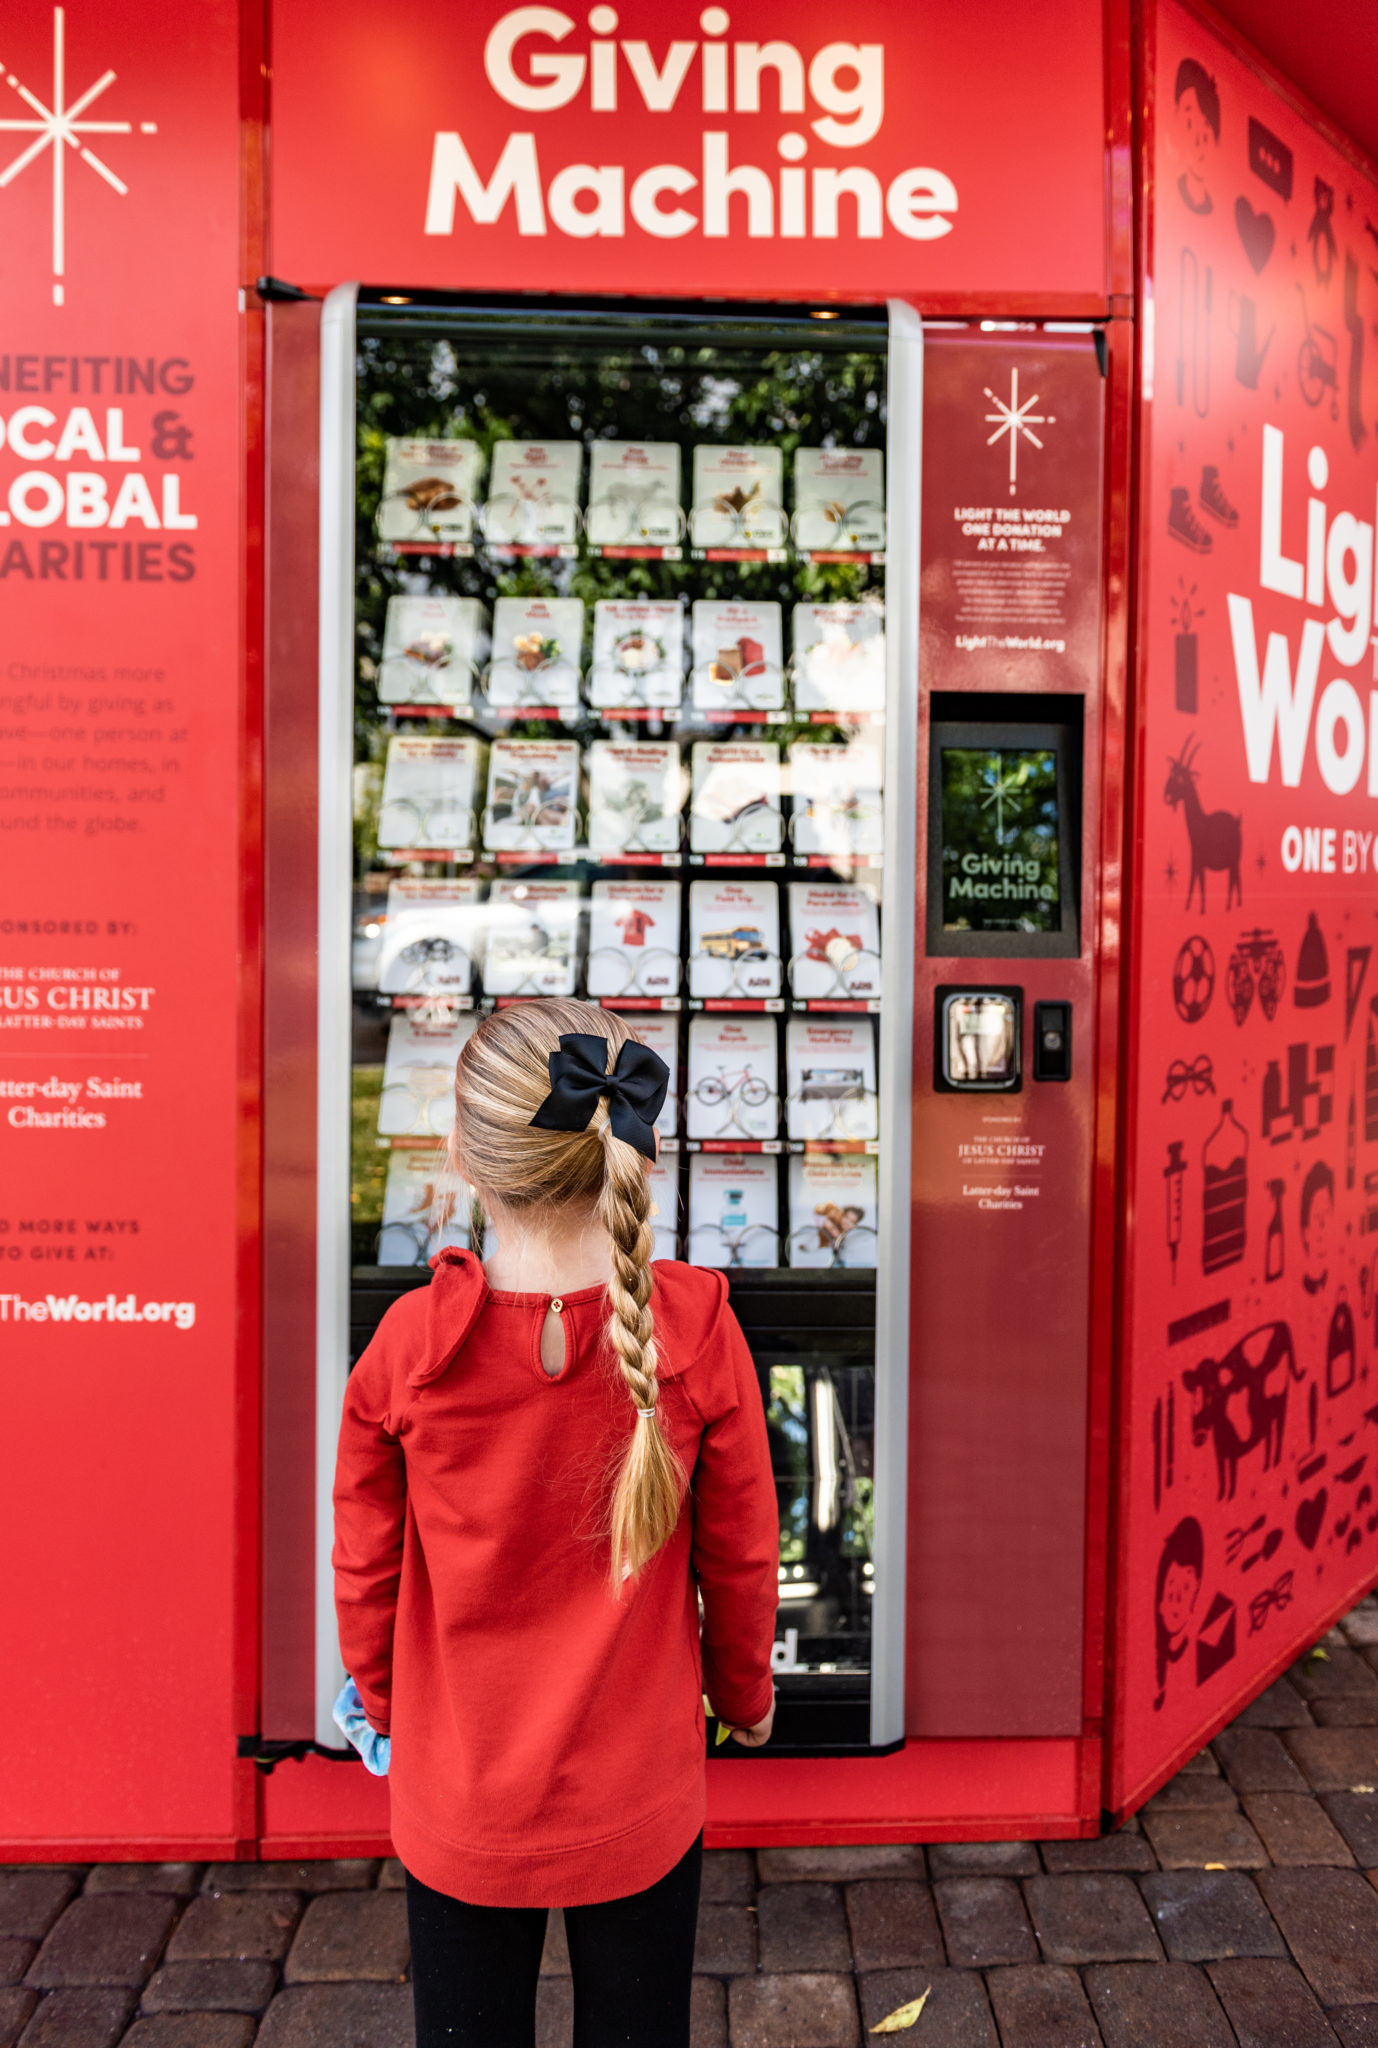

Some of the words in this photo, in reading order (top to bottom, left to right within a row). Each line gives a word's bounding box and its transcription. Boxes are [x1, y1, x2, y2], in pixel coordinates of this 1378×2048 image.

[484, 5, 884, 148] Giving
[424, 132, 958, 240] Machine
[0, 405, 141, 462] CAL
[152, 410, 194, 460] &
[0, 470, 198, 529] OBAL
[954, 507, 993, 521] LIGHT
[996, 508, 1021, 522] THE
[1022, 509, 1071, 523] WORLD
[962, 523, 990, 536] ONE
[992, 524, 1062, 538] DONATION
[977, 538, 996, 551] AT
[997, 538, 1009, 551] A
[1010, 539, 1046, 552] TIME.
[1260, 422, 1378, 667] Lig
[955, 635, 1065, 653] LightTheWorld.org
[7, 662, 107, 682] Christmas
[113, 667, 166, 682] more
[58, 692, 81, 714] by
[87, 693, 146, 716] giving
[152, 697, 174, 714] as
[93, 727, 162, 745] person
[169, 726, 189, 743] at
[42, 756, 75, 771] our
[161, 755, 181, 773] in
[127, 785, 166, 802] and
[46, 813, 78, 831] the
[84, 813, 145, 836] globe.
[1282, 825, 1336, 873] ONE
[1342, 829, 1372, 874] BY
[961, 853, 1041, 882] Giving
[949, 877, 1054, 900] Machine
[107, 920, 138, 935] BY:
[28, 967, 97, 981] CHURCH
[100, 968, 121, 981] OF
[0, 986, 40, 1010] US
[47, 986, 155, 1010] CHRIST
[91, 1015, 144, 1030] SAINTS
[86, 1076, 143, 1098] Saint
[8, 1106, 106, 1128] Charities
[958, 1144, 994, 1157] JESUS
[996, 1144, 1046, 1157] CHRIST
[1014, 1185, 1039, 1197] Saint
[978, 1198, 1023, 1210] Charities
[19, 1219, 76, 1234] MORE
[86, 1220, 139, 1234] WAYS
[30, 1247, 75, 1261] GIVE
[0, 1294, 195, 1329] TheWorld.org
